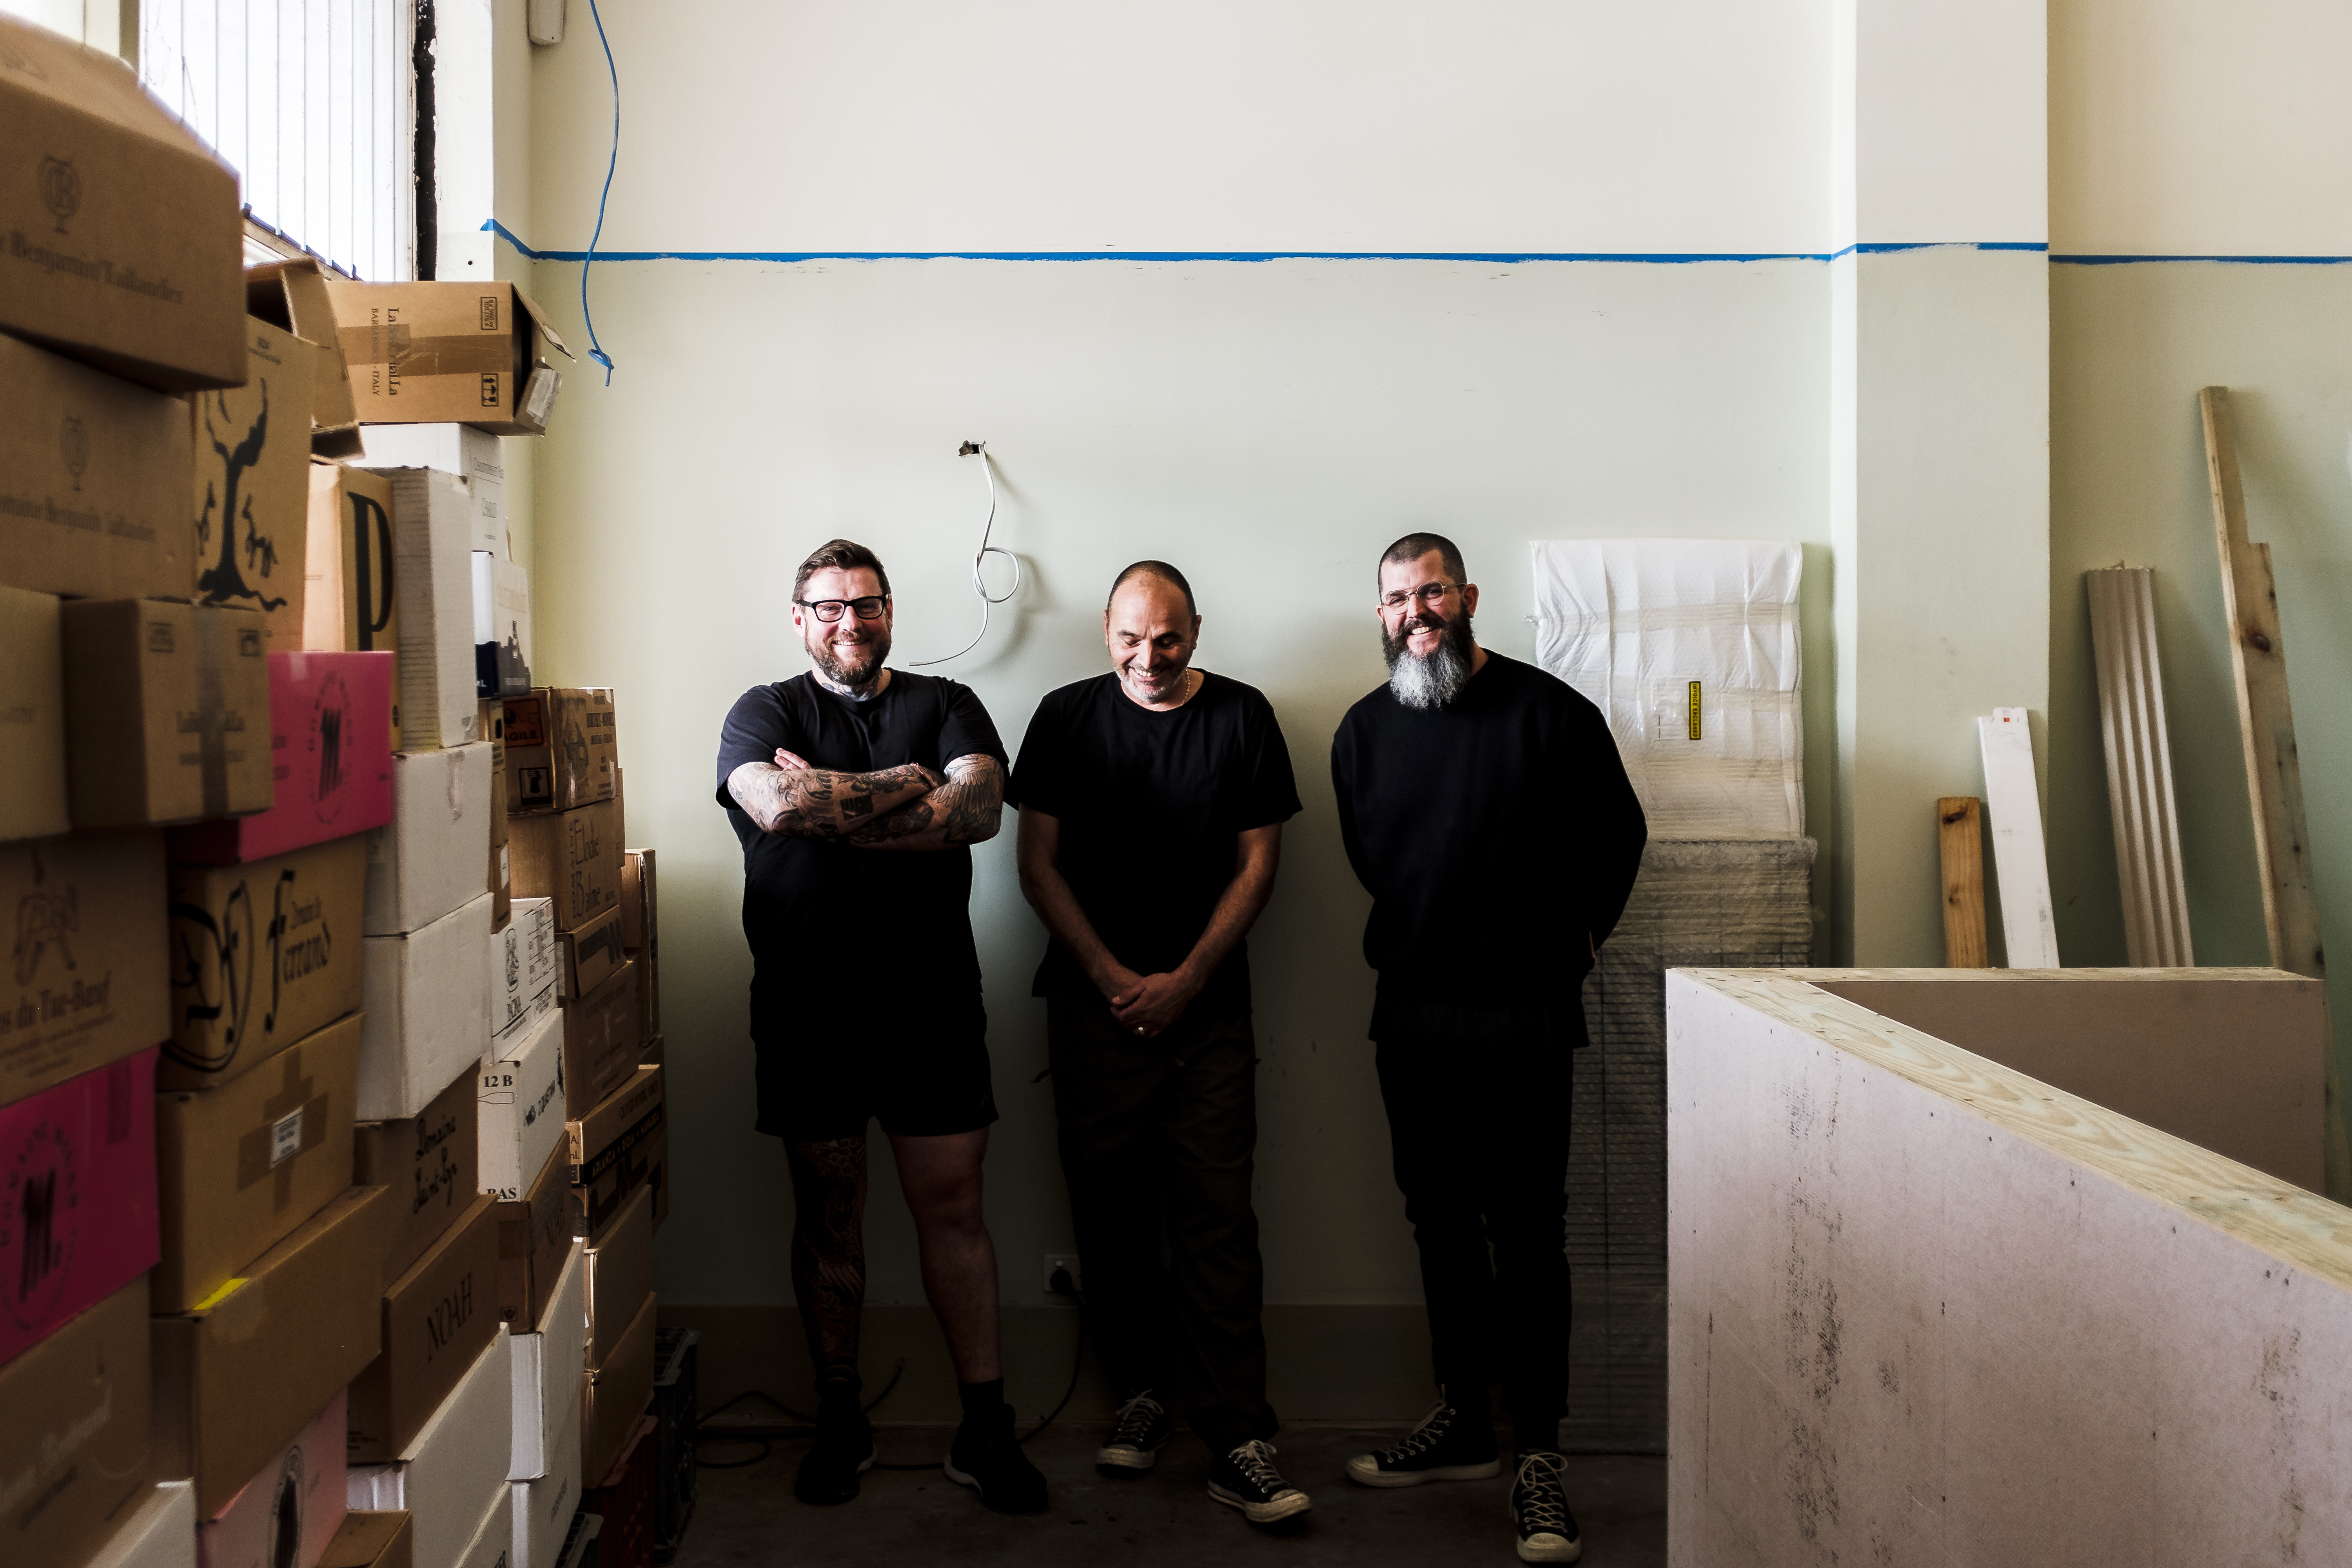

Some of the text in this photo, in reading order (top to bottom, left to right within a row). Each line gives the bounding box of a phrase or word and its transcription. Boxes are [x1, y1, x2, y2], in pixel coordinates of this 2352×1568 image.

[505, 730, 538, 741] AGILE
[483, 1075, 513, 1087] 12 B
[592, 1147, 615, 1178] ARLANZA
[622, 1132, 635, 1153] RIOJA
[641, 1111, 659, 1136] NAVARRA
[427, 1272, 473, 1363] NOAH
